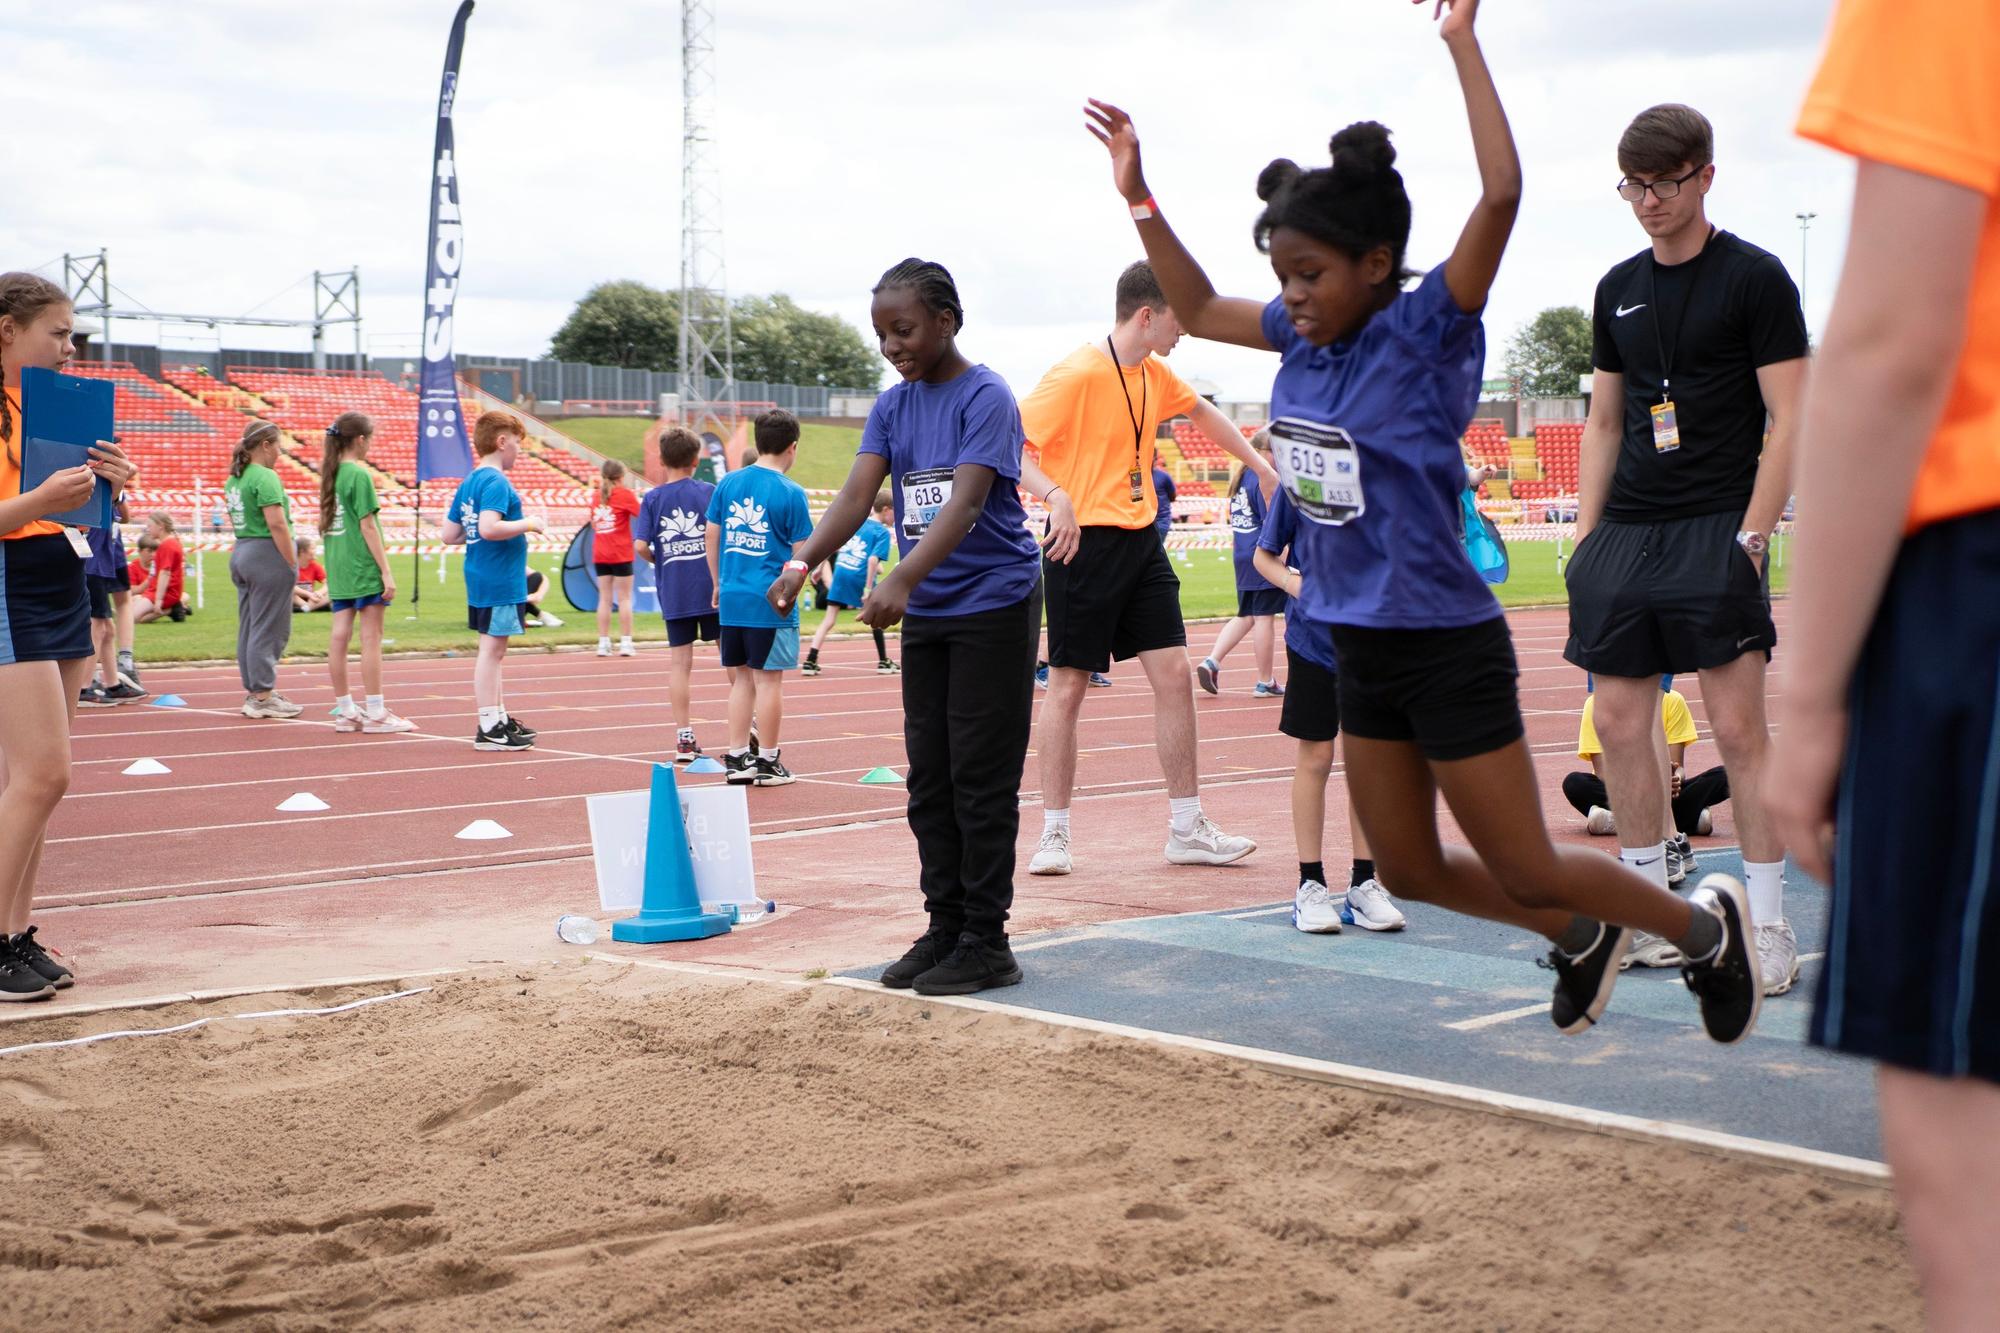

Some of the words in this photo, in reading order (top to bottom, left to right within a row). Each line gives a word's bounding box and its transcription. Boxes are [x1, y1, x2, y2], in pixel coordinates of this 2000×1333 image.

[424, 149, 463, 362] Start
[1291, 447, 1325, 477] 619
[914, 486, 943, 506] 618
[671, 541, 706, 555] SPORT
[735, 536, 767, 550] SPORT
